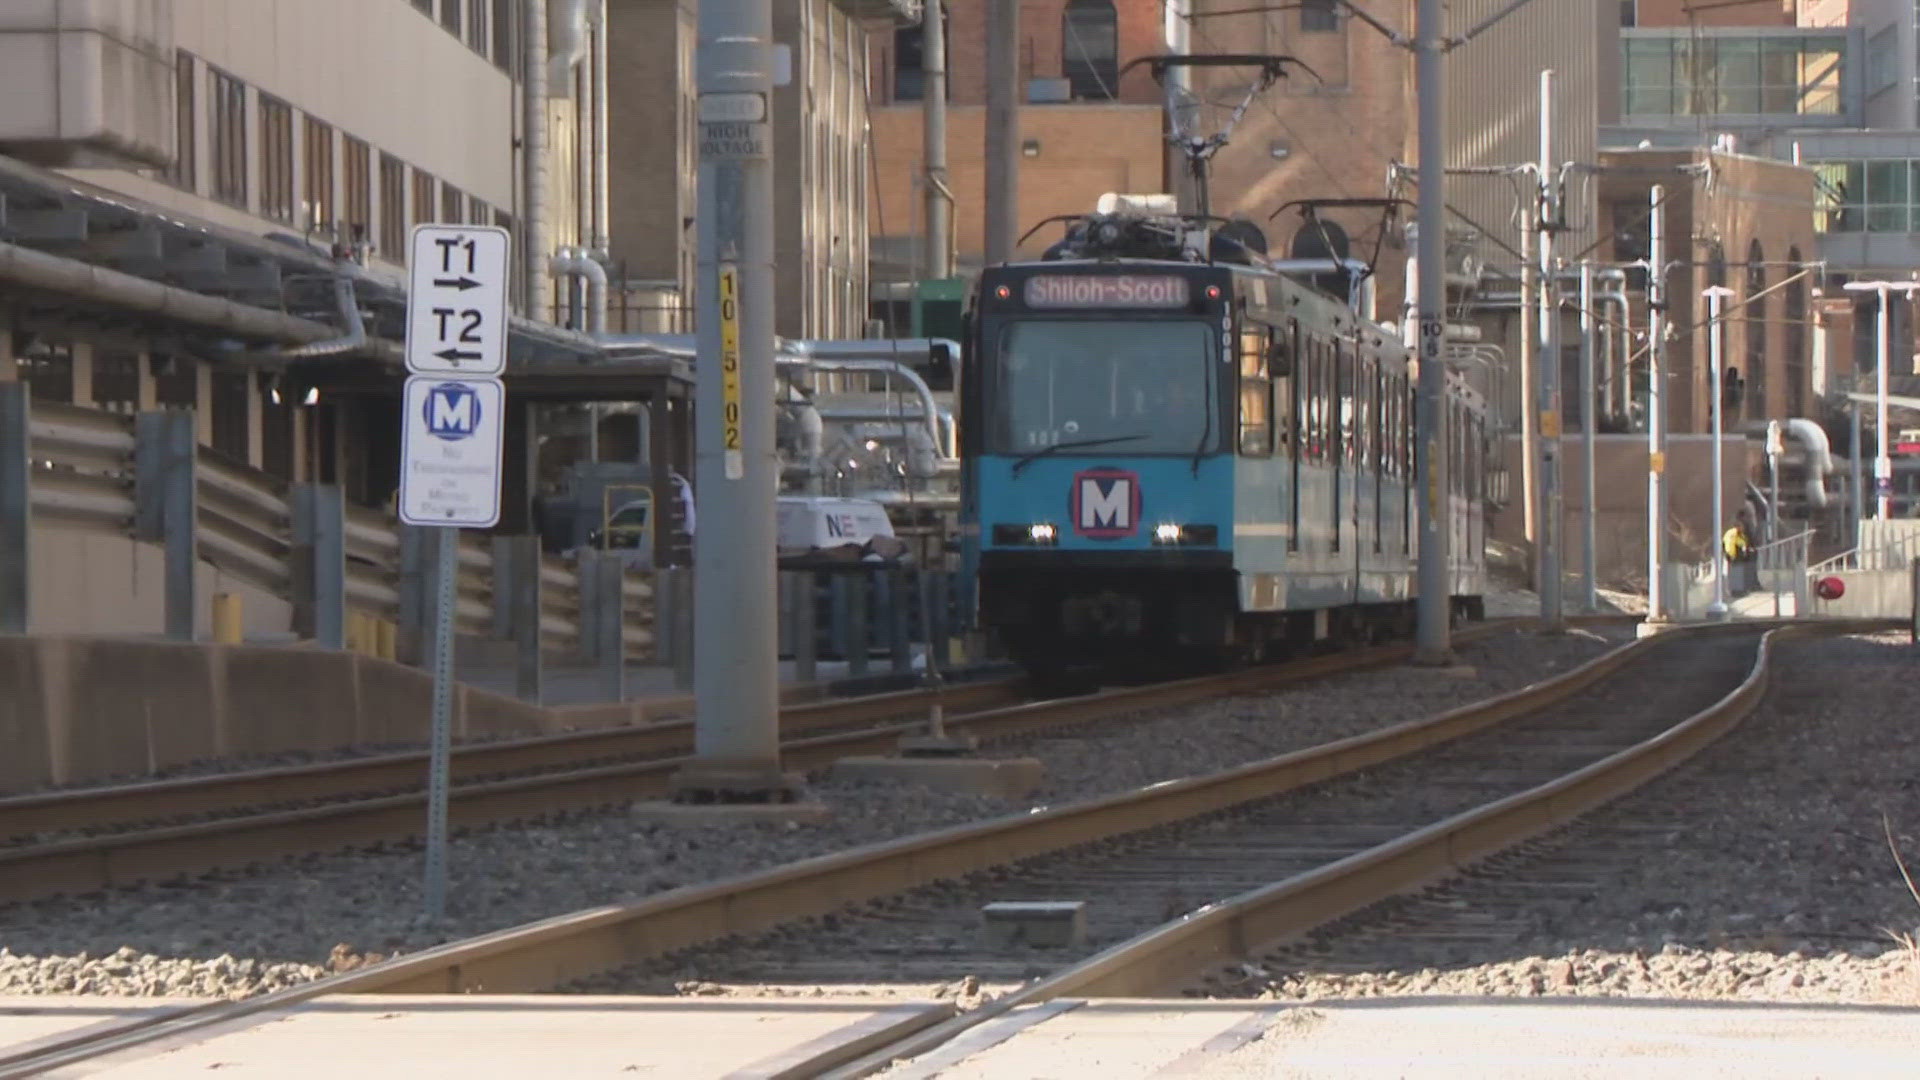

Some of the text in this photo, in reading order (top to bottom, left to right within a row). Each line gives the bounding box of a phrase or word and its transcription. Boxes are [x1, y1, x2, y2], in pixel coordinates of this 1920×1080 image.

[707, 126, 750, 139] HIGH
[435, 238, 475, 273] T1
[1030, 275, 1184, 302] Shiloh-Scott
[432, 307, 482, 343] T2
[1422, 322, 1442, 337] 10
[432, 391, 473, 432] M
[1080, 478, 1131, 530] M
[825, 513, 856, 538] NE
